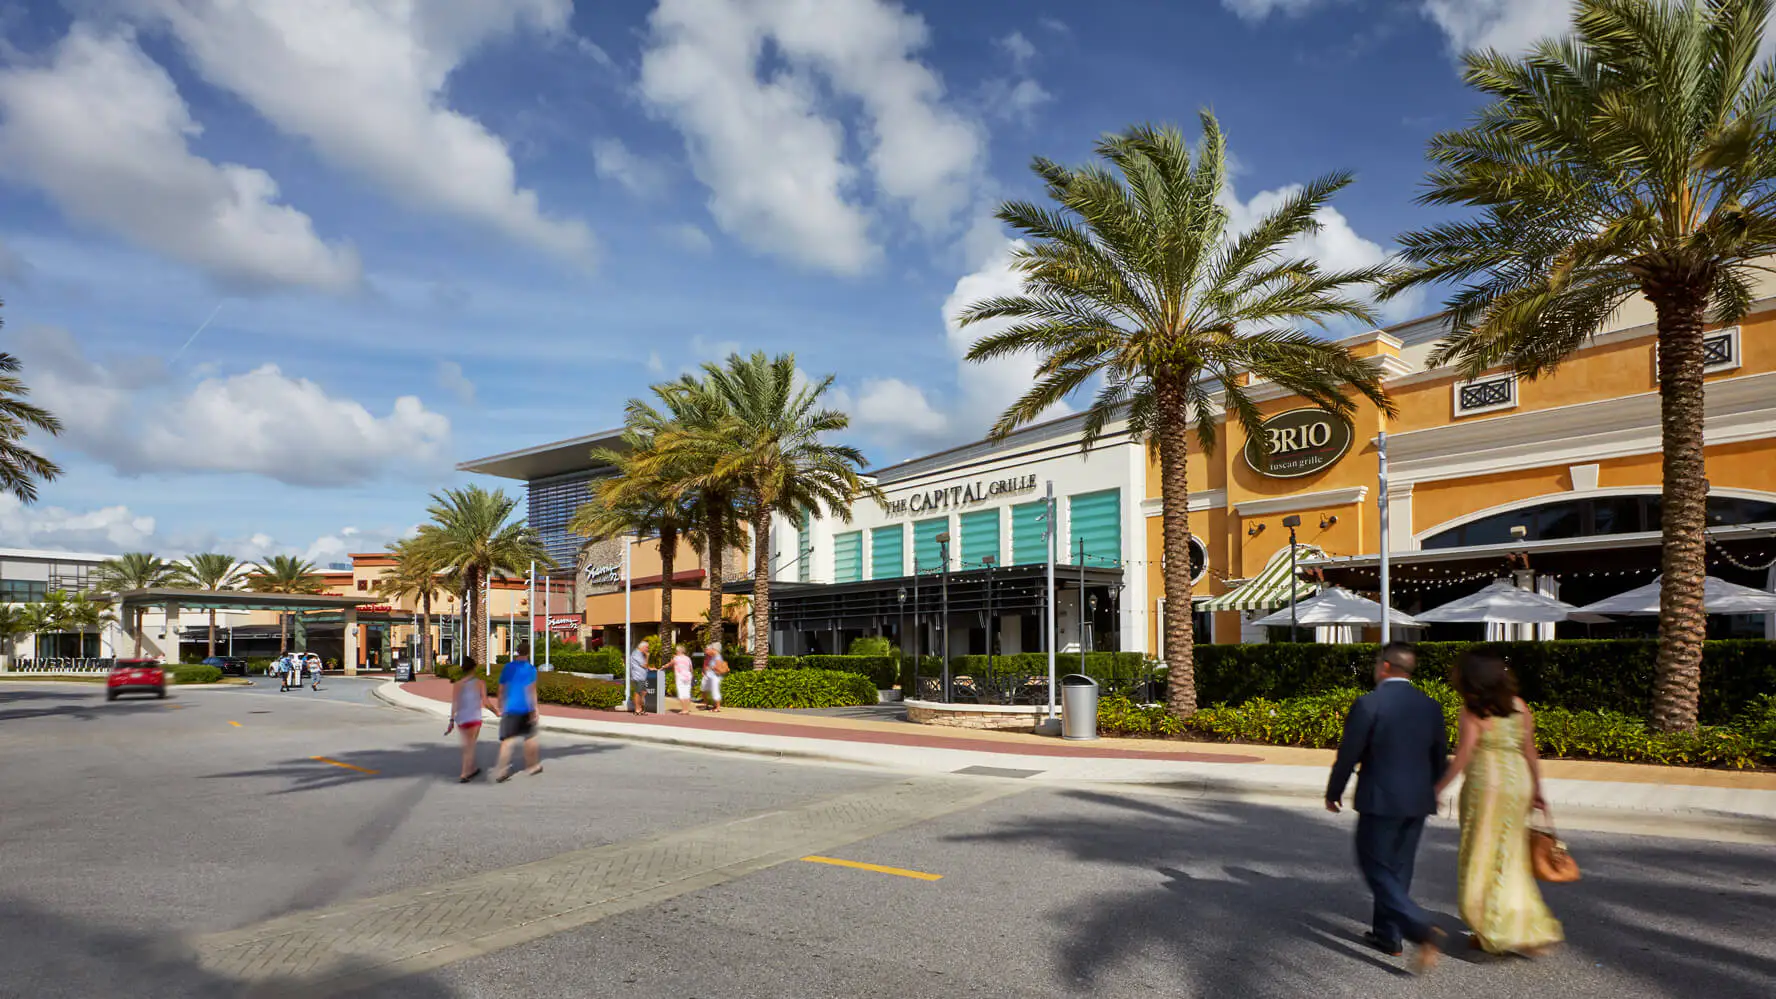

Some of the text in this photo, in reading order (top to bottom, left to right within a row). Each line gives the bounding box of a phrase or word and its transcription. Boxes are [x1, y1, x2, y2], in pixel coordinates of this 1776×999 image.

[1264, 421, 1332, 455] BRIO
[1270, 455, 1324, 471] tuscan grille
[884, 473, 1037, 514] THE CAPITAL GRILLE
